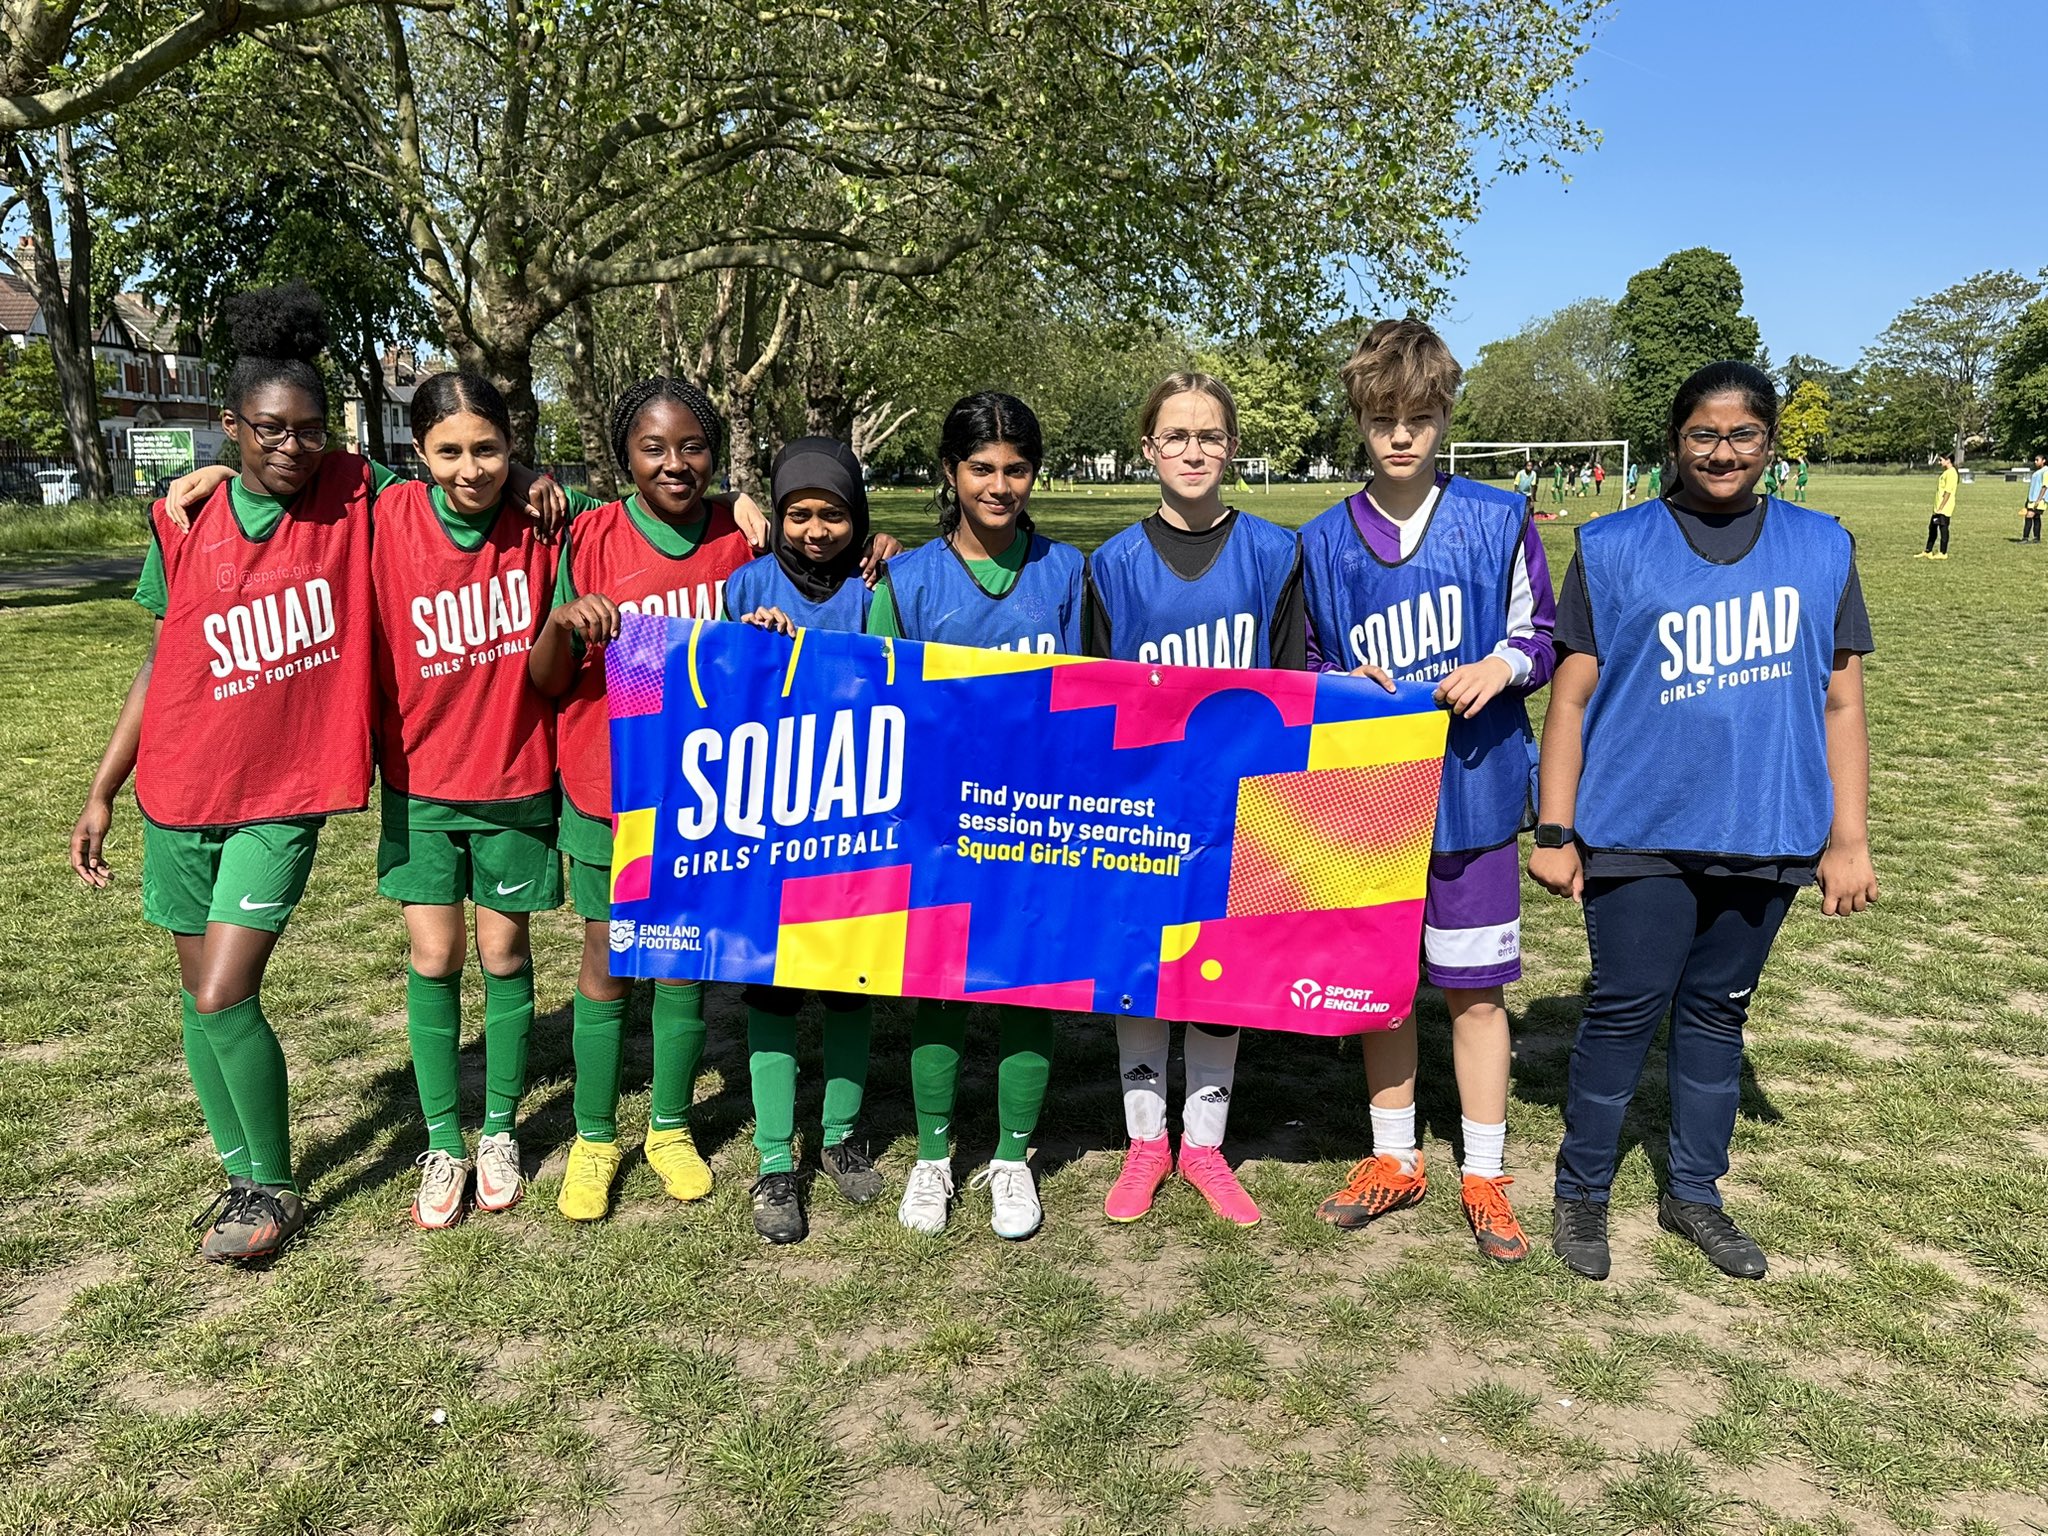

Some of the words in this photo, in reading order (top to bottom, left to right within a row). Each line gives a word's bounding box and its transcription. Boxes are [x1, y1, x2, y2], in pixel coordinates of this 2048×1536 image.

[239, 560, 322, 587] @cpafc.girls
[203, 577, 336, 678] SQUAD
[411, 569, 532, 658] SQUAD
[1350, 585, 1462, 679] SQUAD
[469, 636, 533, 667] FOOTBALL
[1658, 585, 1800, 682] SQUAD
[265, 646, 341, 685] FOOTBALL
[1718, 661, 1792, 690] FOOTBALL
[676, 704, 906, 840] SQUAD
[960, 780, 1007, 806] Find
[1013, 789, 1064, 811] your
[1068, 794, 1155, 818] nearest
[770, 827, 899, 865] FOOTBALL
[958, 812, 1043, 837] session
[1048, 816, 1075, 842] by
[1078, 823, 1191, 854] searching
[956, 835, 1025, 864] Squad
[1092, 847, 1180, 877] Football
[638, 936, 703, 951] FOOTBALL
[639, 923, 701, 939] ENGLAND
[1323, 999, 1390, 1013] ENGLAND
[1325, 985, 1374, 1000] SPORT
[1123, 1071, 1159, 1081] adidas
[1200, 1093, 1231, 1103] adida
